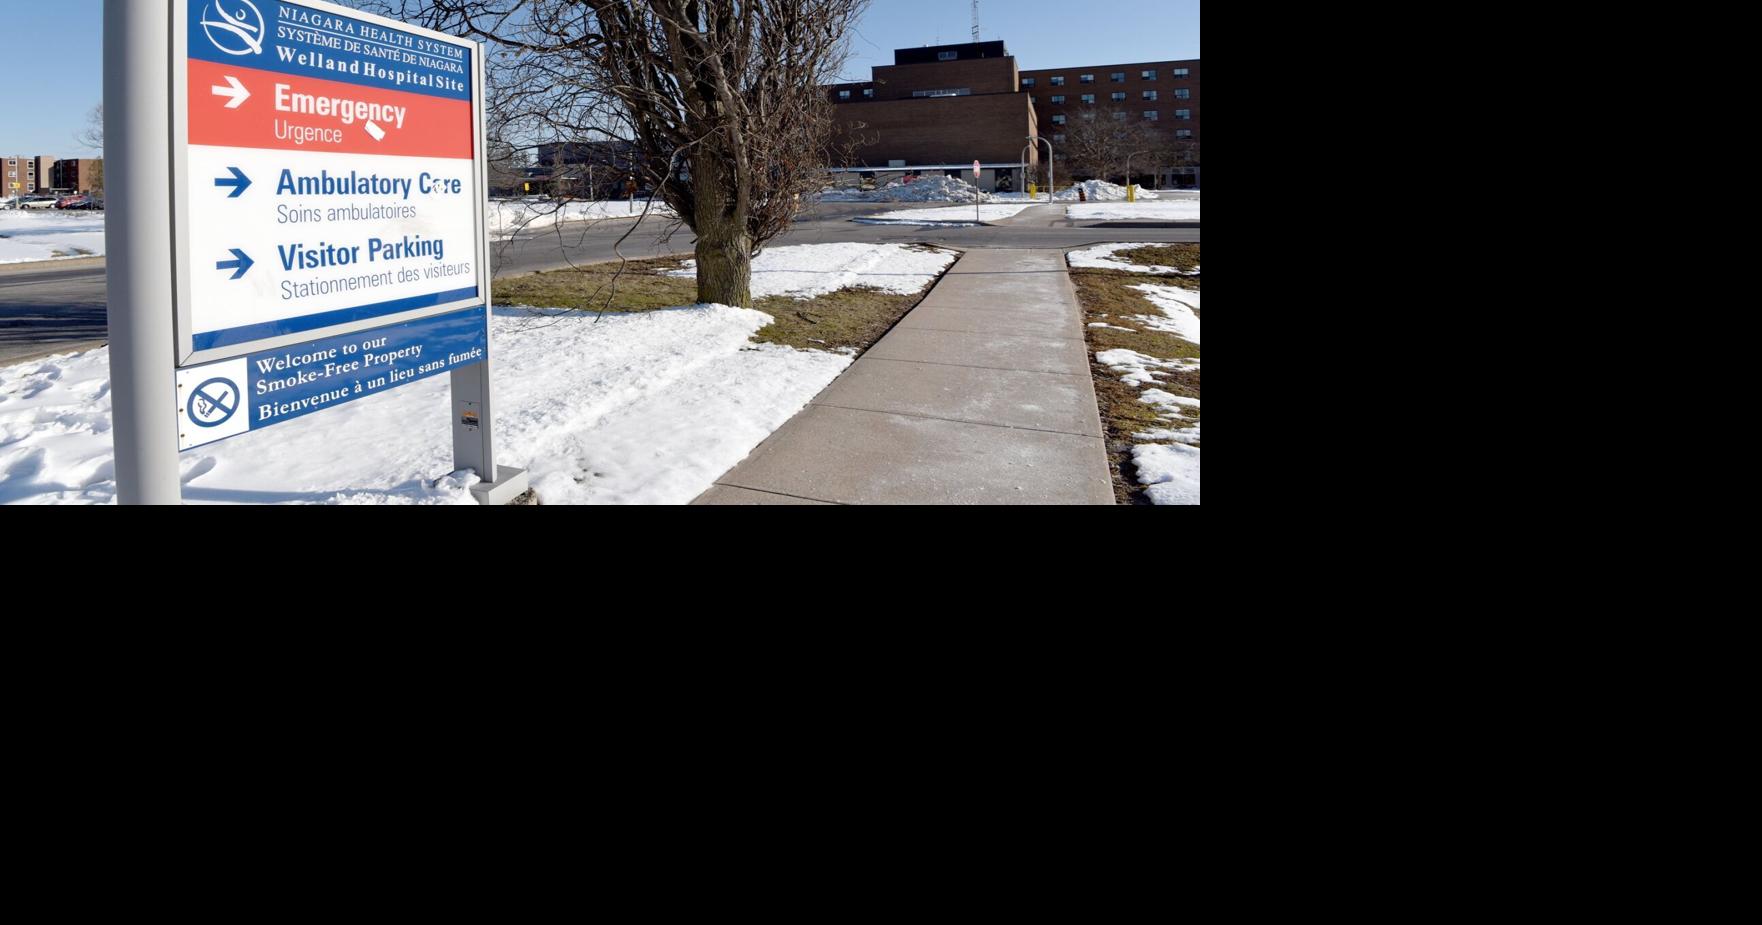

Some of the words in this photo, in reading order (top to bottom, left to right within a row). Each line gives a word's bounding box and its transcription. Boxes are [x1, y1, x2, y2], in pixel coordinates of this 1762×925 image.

[277, 25, 342, 50] SYSTÈME
[344, 40, 361, 54] DE
[363, 43, 400, 62] SANTÉ
[402, 52, 417, 65] DE
[418, 56, 464, 74] NIAGARA
[278, 5, 355, 34] NIAGARA
[360, 25, 413, 48] HEALTH
[417, 39, 463, 59] SYSTEM
[275, 45, 360, 75] Welland
[363, 61, 433, 86] Hospital
[436, 75, 464, 92] Site
[274, 82, 406, 129] Emergency
[274, 119, 343, 145] Urgence
[276, 168, 412, 200] Ambulatory
[276, 204, 322, 224] Soins
[327, 203, 417, 221] ambulatoires
[277, 242, 360, 271] Visitor
[368, 235, 444, 261] Parking
[280, 270, 394, 300] Stationnement
[397, 265, 420, 284] des
[423, 260, 471, 279] visiteurs
[256, 348, 337, 374] Welcome
[342, 343, 357, 355] to
[362, 337, 387, 350] our
[256, 361, 359, 395] Smoke-Free
[364, 344, 423, 368] Property
[258, 387, 349, 421] Bienvenue
[354, 380, 363, 394] à
[367, 377, 385, 390] un
[390, 367, 415, 381] lieu
[418, 359, 446, 374] sans
[449, 346, 482, 365] fumée
